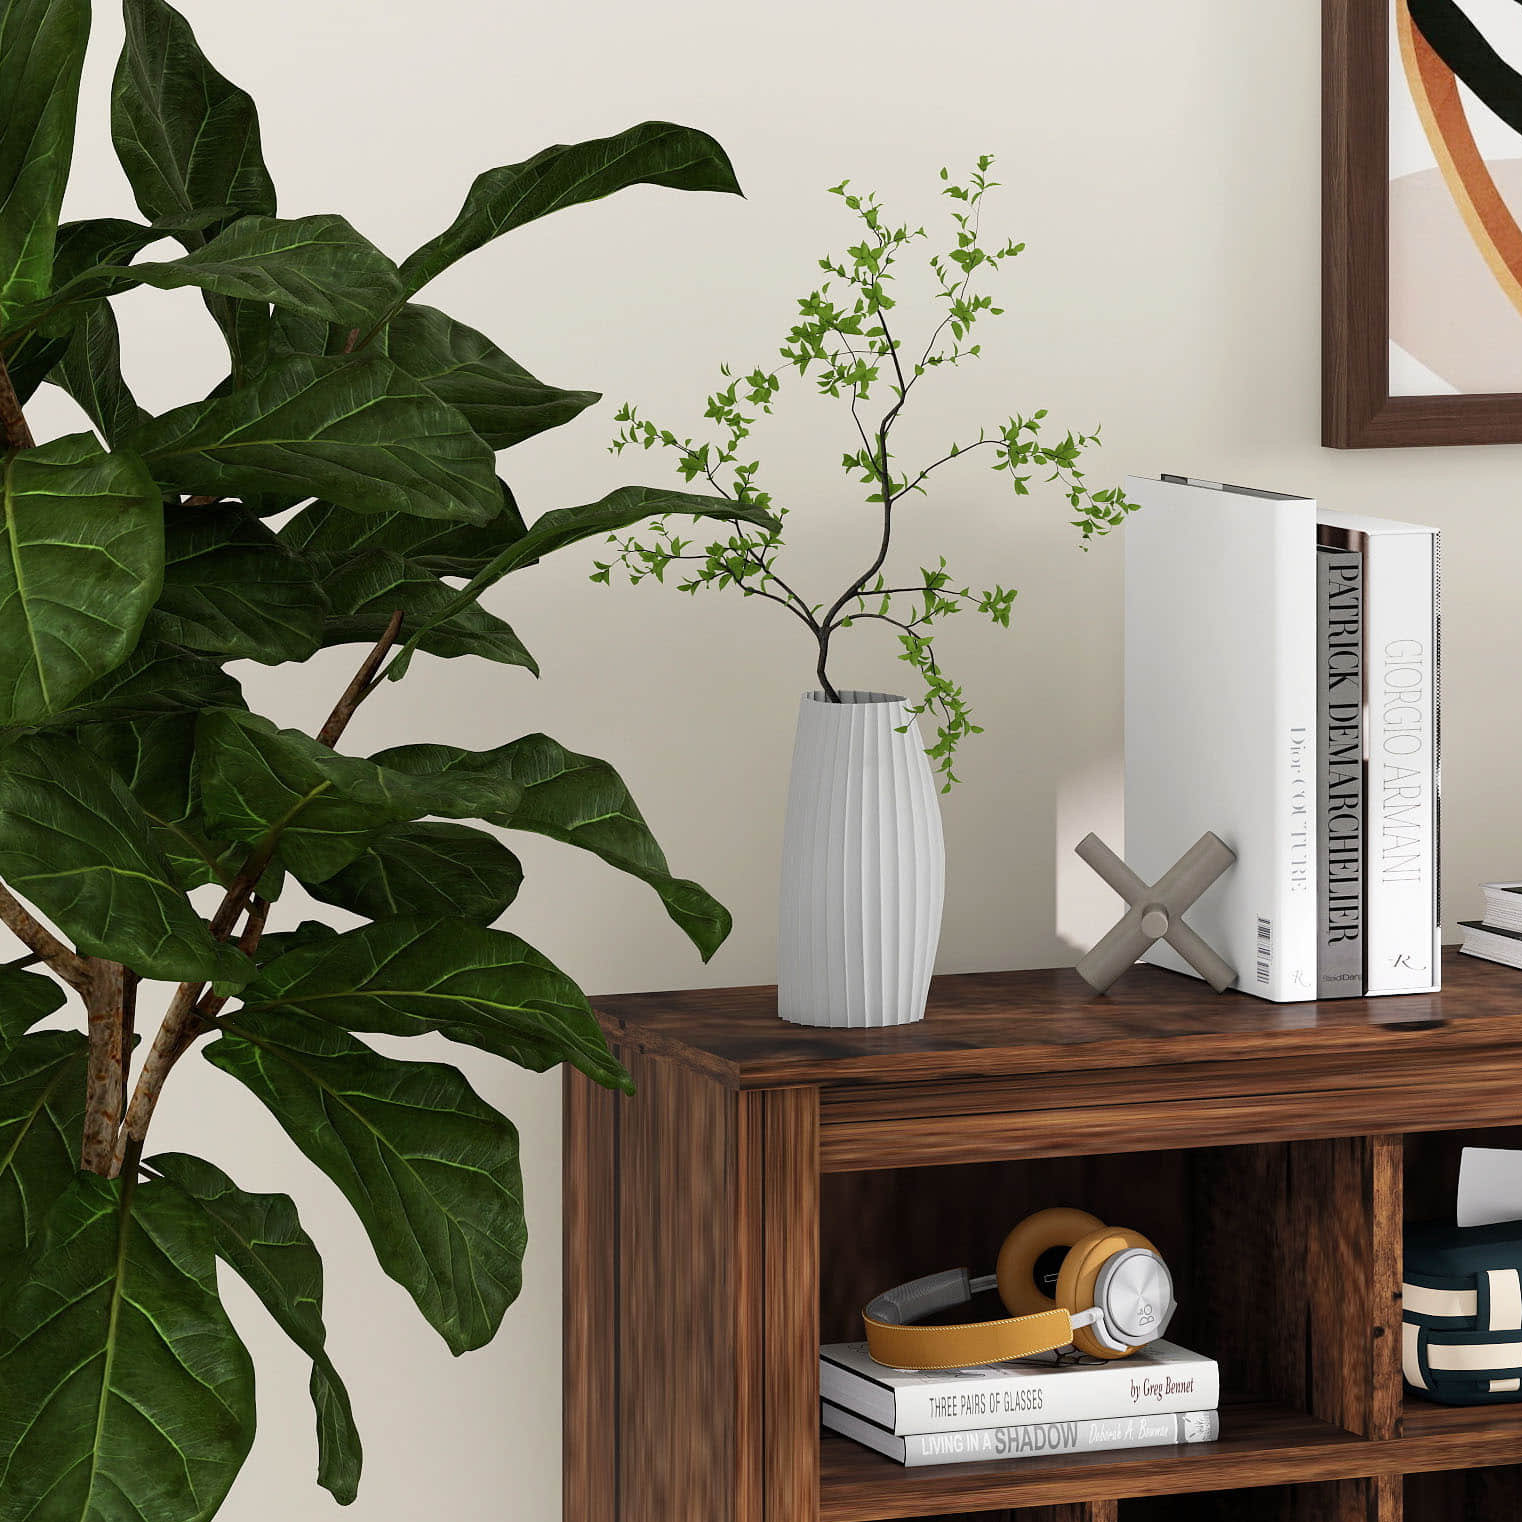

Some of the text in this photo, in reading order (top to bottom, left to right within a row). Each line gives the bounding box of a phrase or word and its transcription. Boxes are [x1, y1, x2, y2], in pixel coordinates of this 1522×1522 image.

[1327, 563, 1360, 691] PATRICK
[1289, 727, 1307, 774] Dior
[1382, 638, 1424, 883] GIORGIO ARMANI
[1326, 702, 1360, 946] DEMARCHELIER
[929, 1388, 1043, 1419] THREE PAIRS OF GLASSES
[1130, 1377, 1195, 1403] by Greg Bennet
[920, 1422, 1079, 1456] LIVING IN A SHADOW
